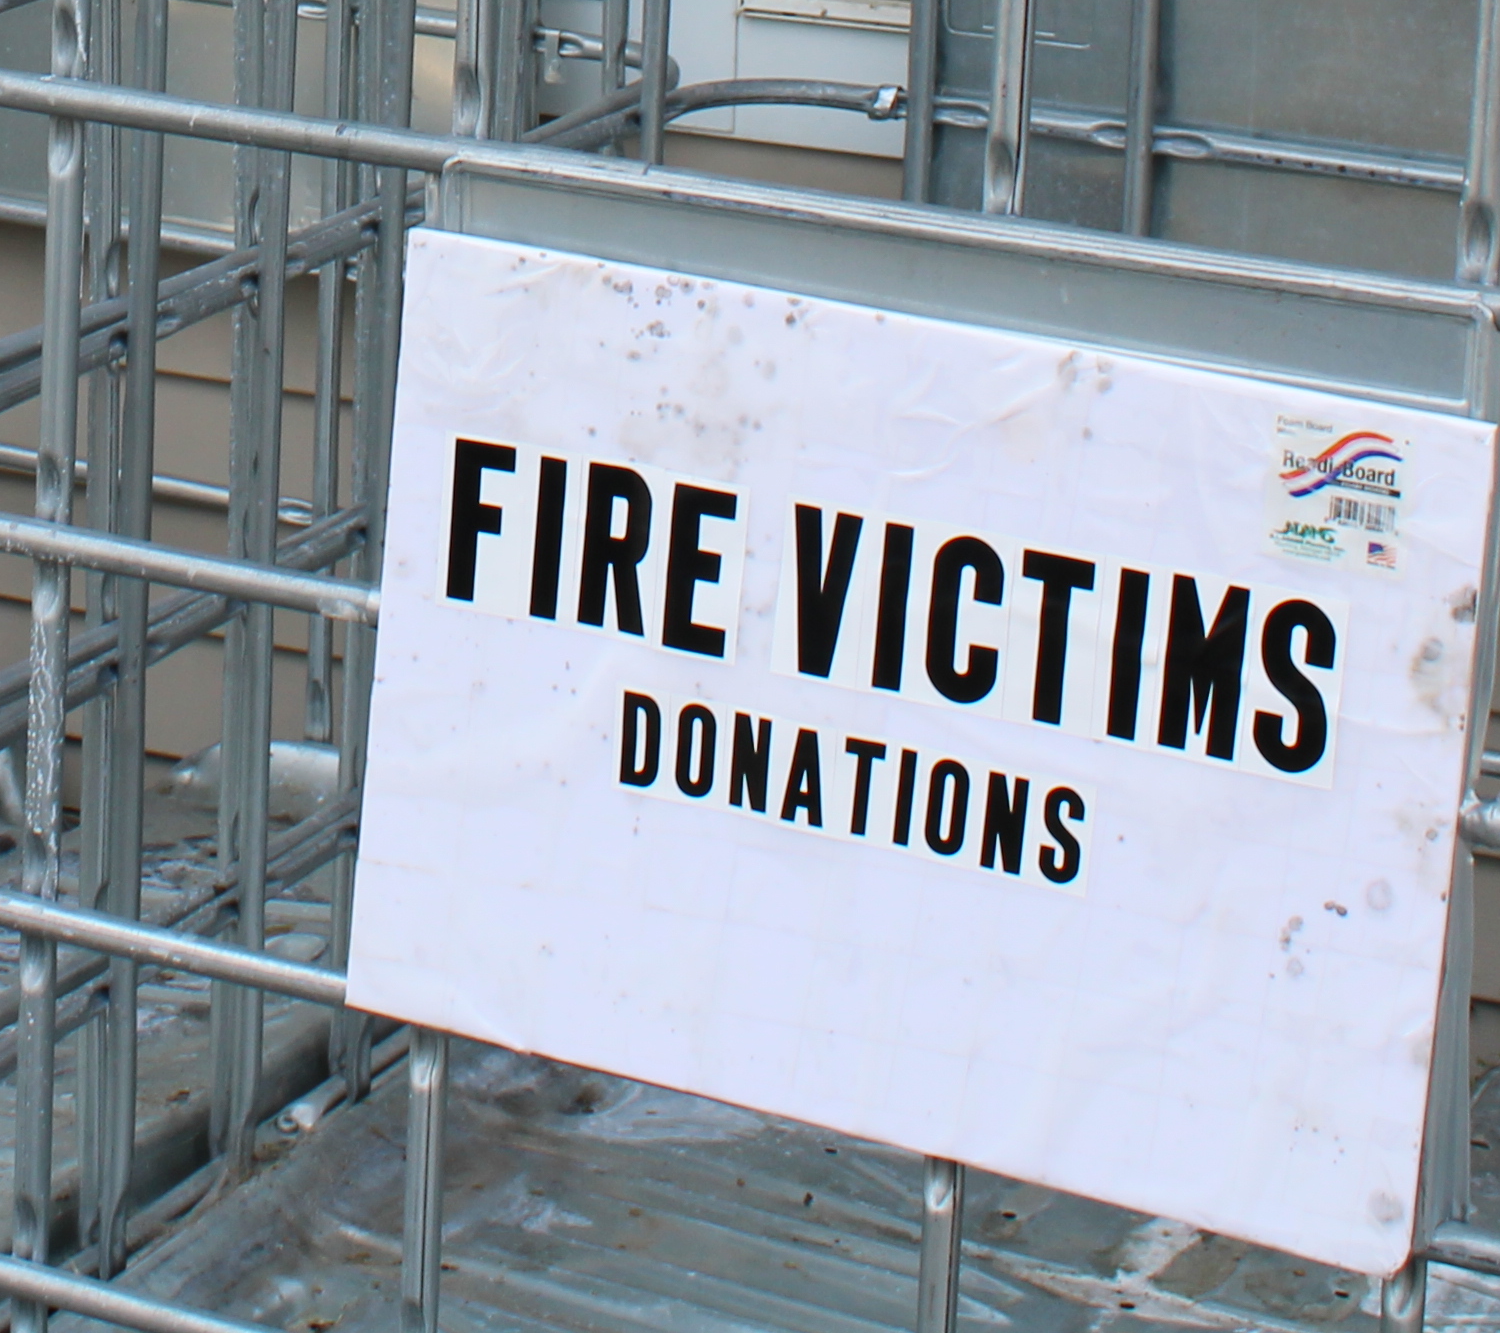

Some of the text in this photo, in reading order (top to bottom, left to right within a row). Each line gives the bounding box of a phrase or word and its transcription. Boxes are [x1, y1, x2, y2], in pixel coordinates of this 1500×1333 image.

[1306, 419, 1334, 433] Board
[443, 436, 1337, 776] FIRE VICTIMS
[619, 688, 1087, 887] DONATIONS
